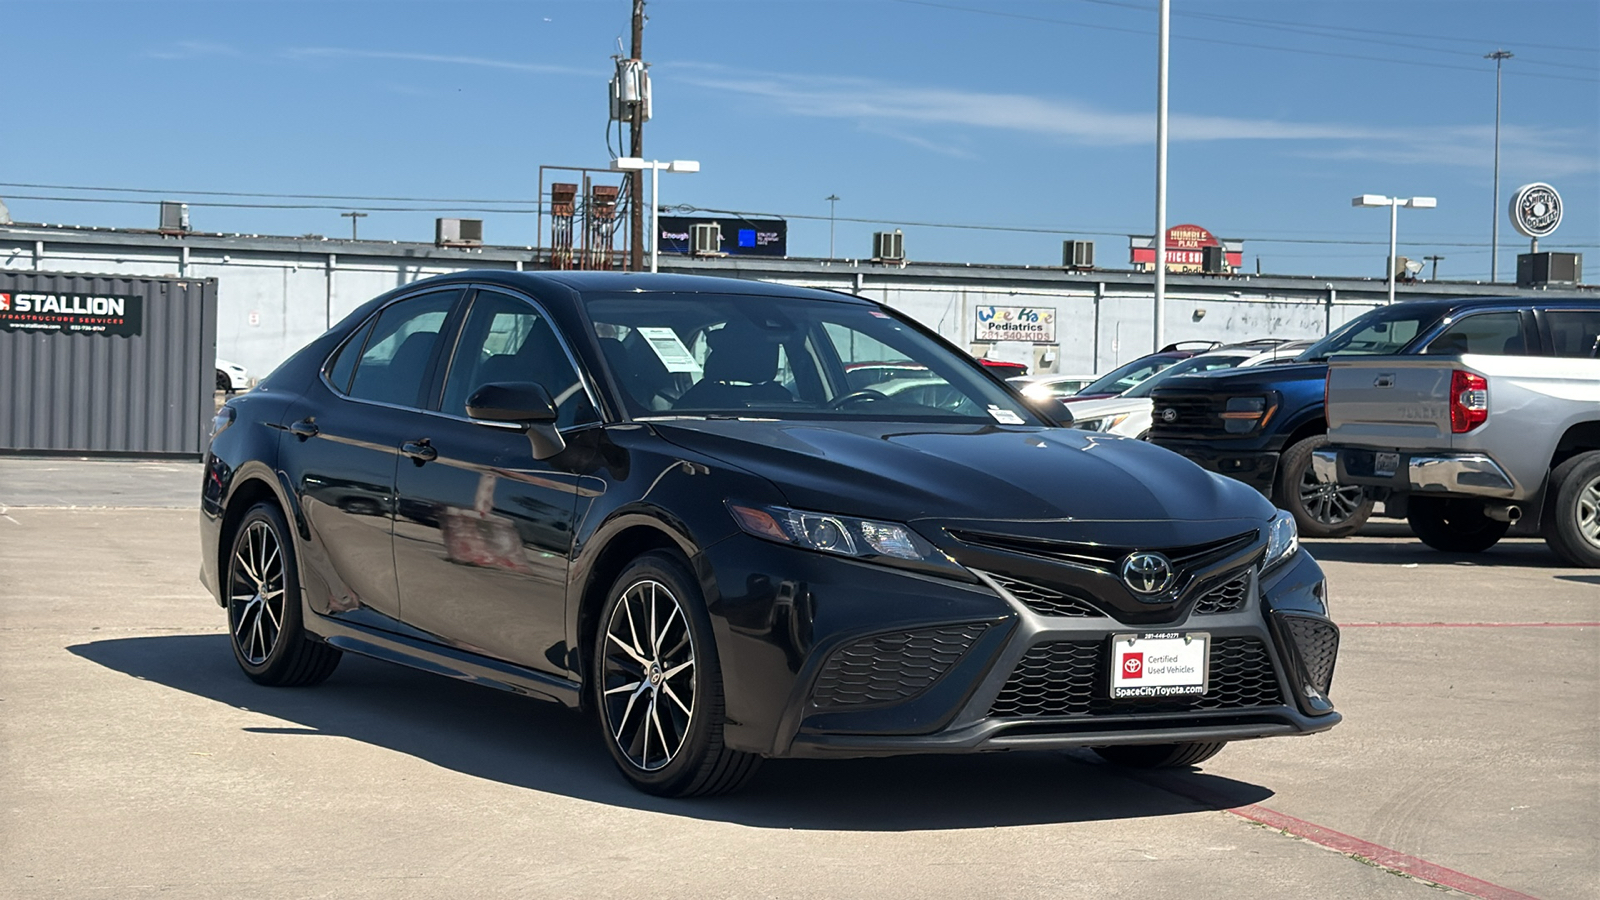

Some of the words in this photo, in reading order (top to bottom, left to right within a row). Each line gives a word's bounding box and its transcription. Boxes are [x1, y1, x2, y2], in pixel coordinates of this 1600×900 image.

[662, 231, 689, 241] Enough
[1170, 230, 1207, 242] HUMBLE
[1178, 240, 1198, 248] PLAZA
[15, 294, 125, 316] STALLION
[978, 306, 1013, 321] Wee
[1017, 308, 1053, 324] Kare
[79, 316, 124, 325] SERVICES
[988, 322, 1043, 332] Pediatrics
[981, 331, 1050, 341] 281-540-KIDS
[1148, 666, 1165, 674] Used
[1166, 665, 1195, 674] Vehicles
[1115, 686, 1203, 697] SpaceCityToyota.com
